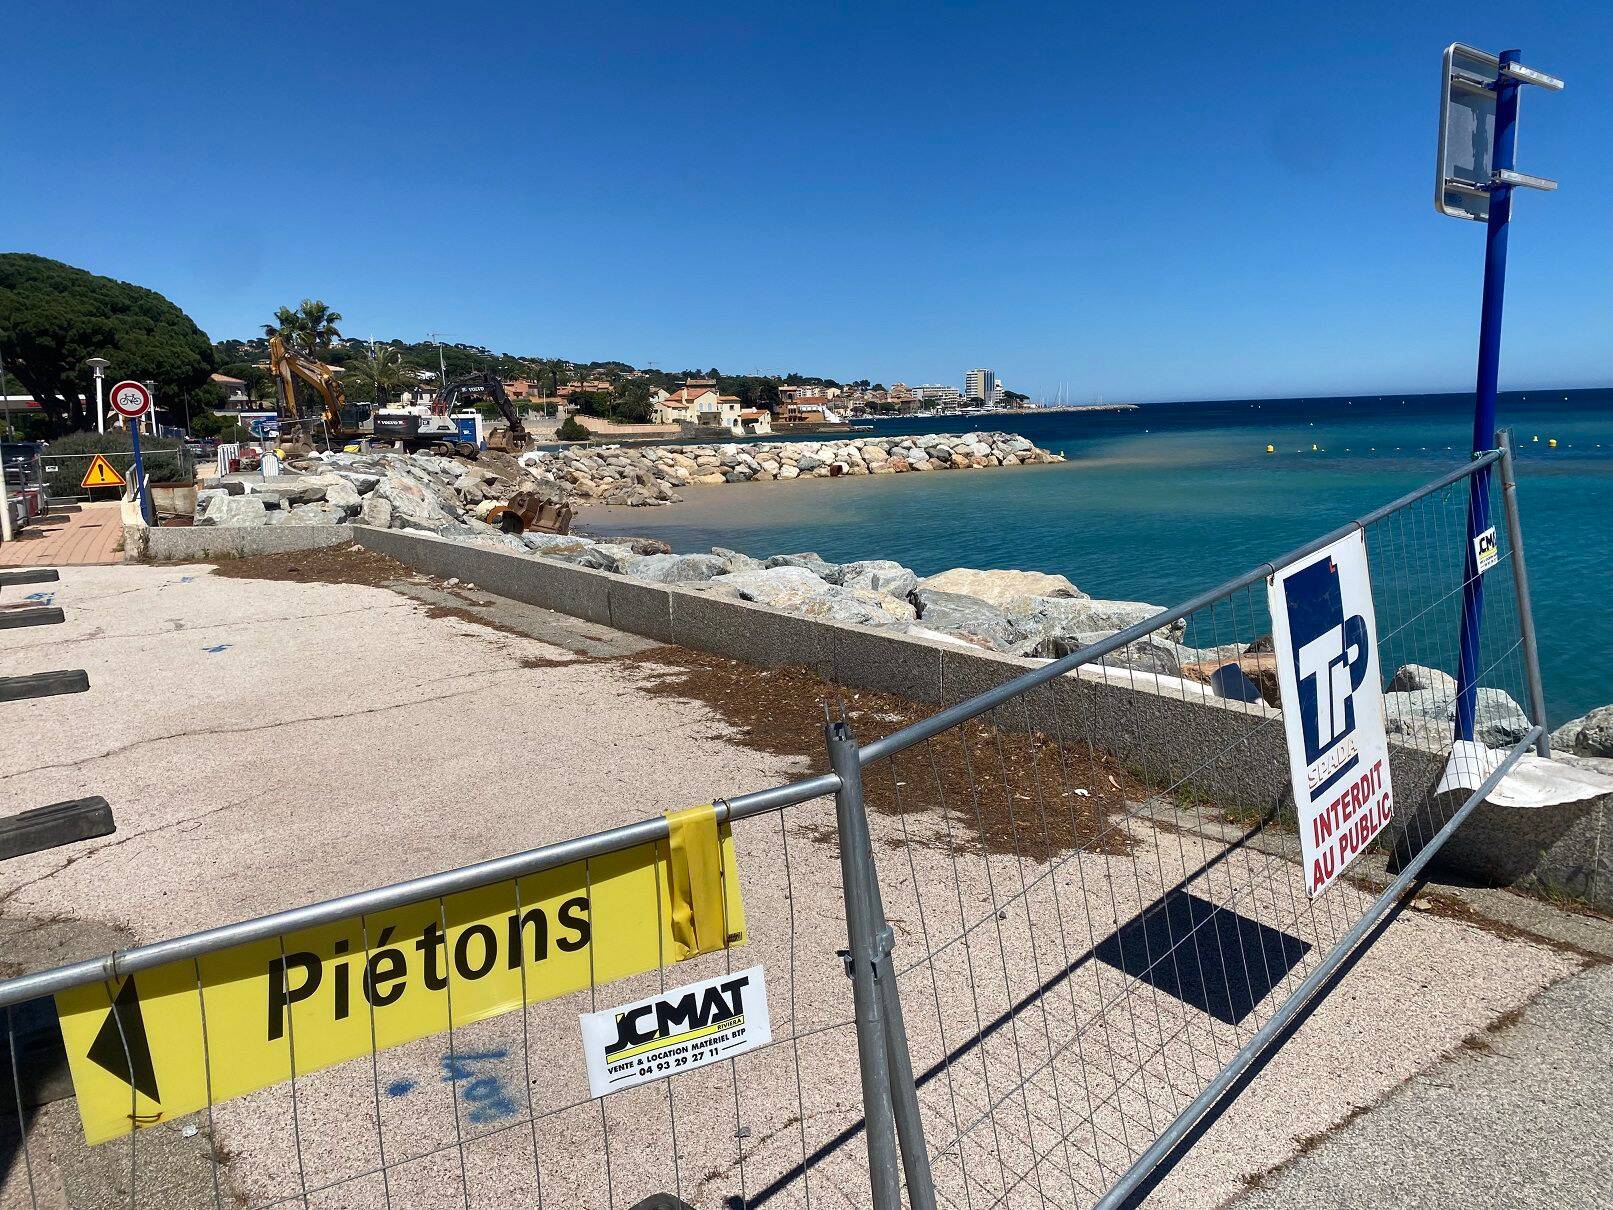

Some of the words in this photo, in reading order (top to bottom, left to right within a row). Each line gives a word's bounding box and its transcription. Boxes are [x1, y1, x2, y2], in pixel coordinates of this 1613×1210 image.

[1307, 738, 1358, 790] SPADA
[1313, 759, 1383, 849] INTERDIT
[1313, 845, 1335, 894] AU
[1339, 791, 1392, 867] PUBLIC
[267, 896, 593, 1042] Piétons
[604, 976, 749, 1056] JCMAT
[717, 1018, 742, 1031] RIVIERA
[608, 1060, 634, 1075] VENTE
[637, 1058, 644, 1066] &
[647, 1046, 688, 1063] LOCATION
[691, 1035, 730, 1050] MATÉRIEL
[732, 1028, 746, 1039] BTP
[639, 1066, 653, 1077] 04
[657, 1060, 670, 1071] 93
[674, 1056, 688, 1067] 29
[691, 1052, 704, 1062] 27
[709, 1047, 719, 1057] 11
